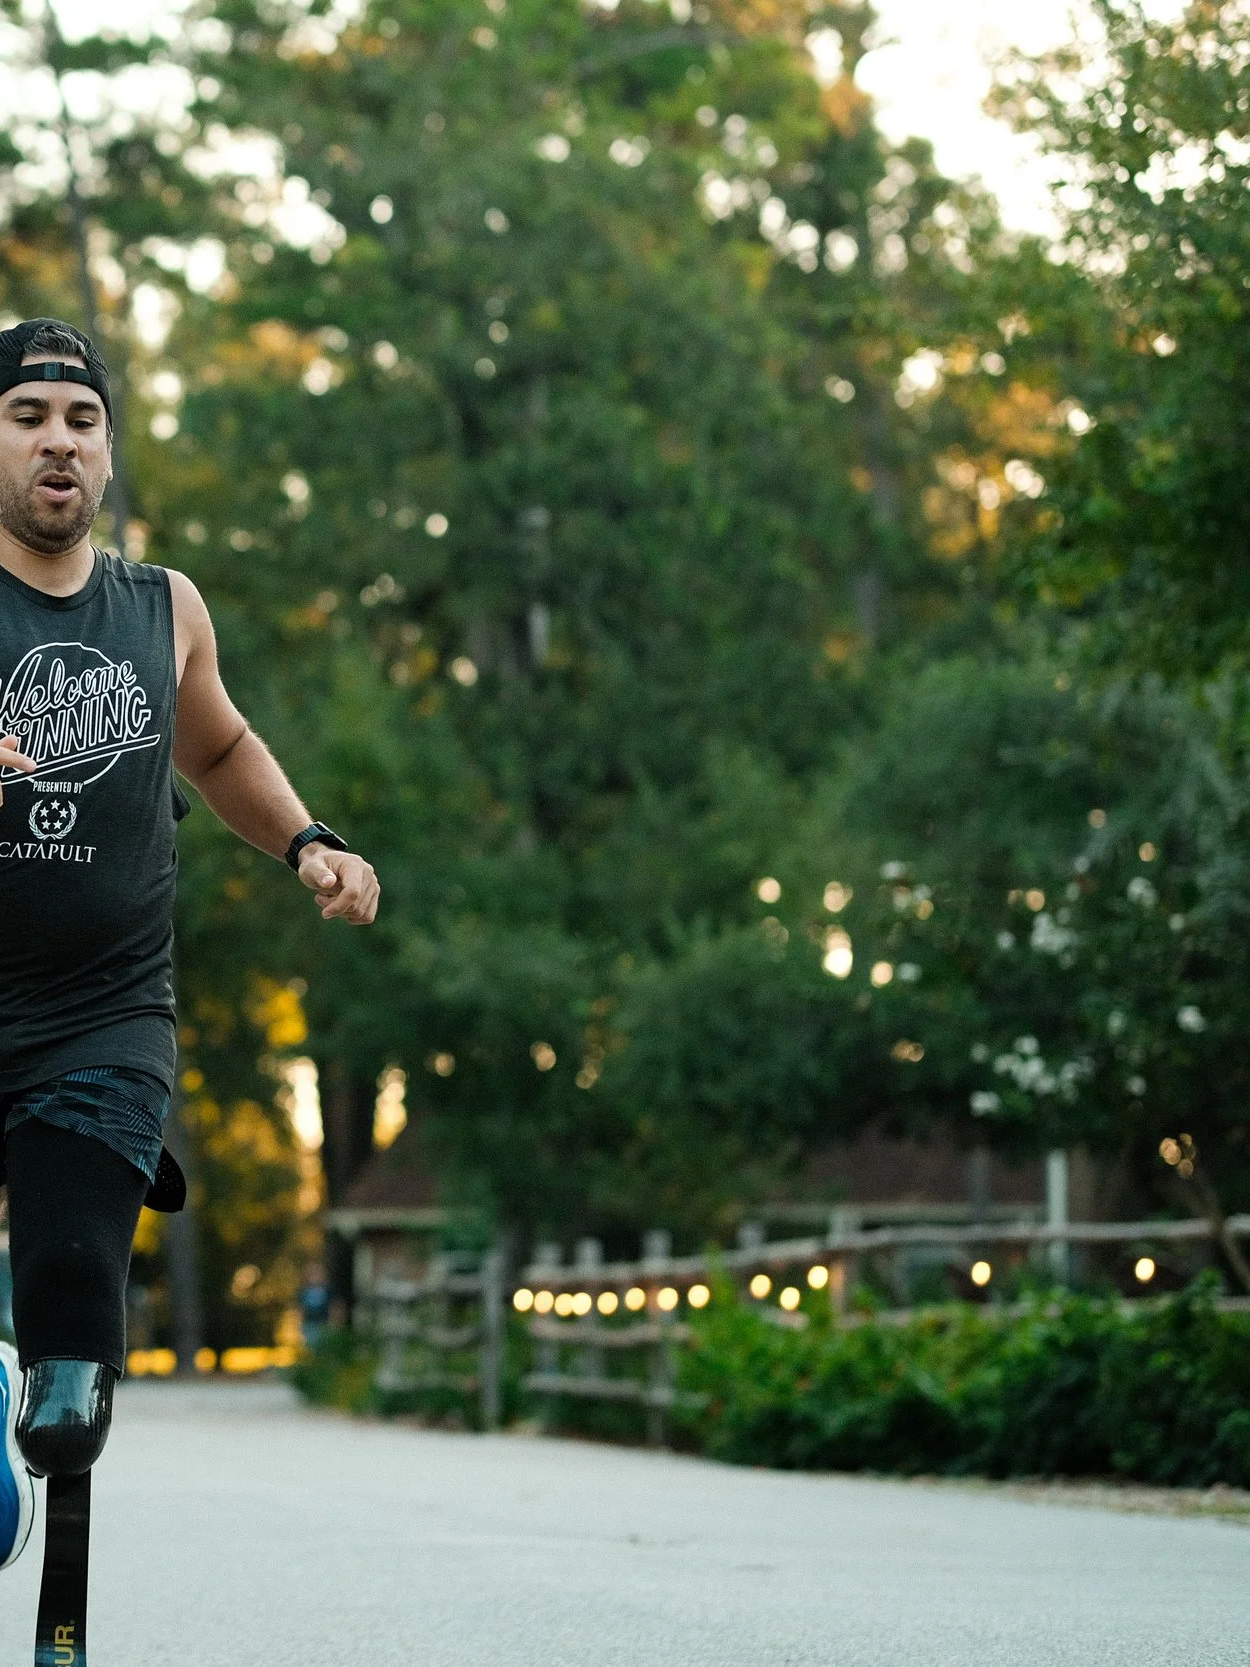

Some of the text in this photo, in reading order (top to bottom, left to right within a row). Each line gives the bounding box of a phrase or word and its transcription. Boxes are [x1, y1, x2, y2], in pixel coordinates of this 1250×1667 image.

[6, 718, 31, 736] TO
[32, 781, 84, 794] PRESENTED BY
